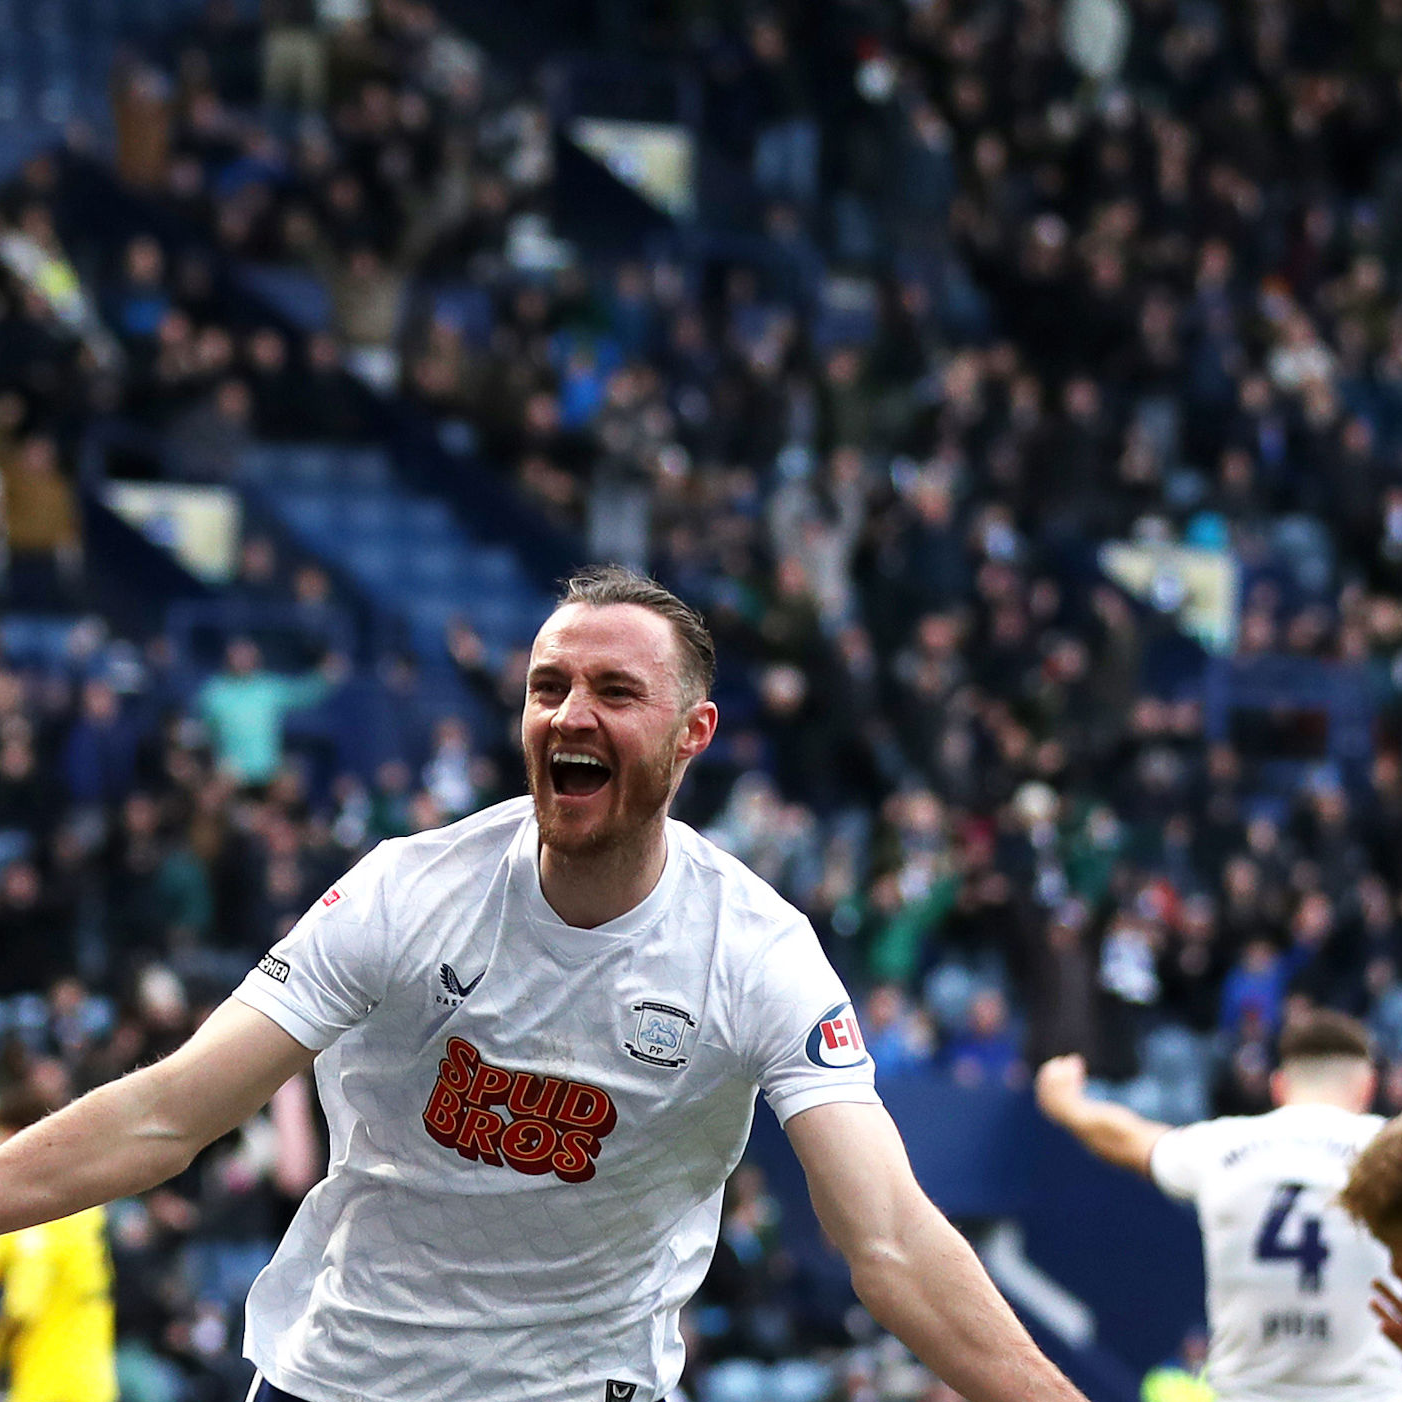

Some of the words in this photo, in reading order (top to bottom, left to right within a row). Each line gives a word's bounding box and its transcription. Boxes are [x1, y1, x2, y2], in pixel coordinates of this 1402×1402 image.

[423, 1077, 599, 1180] BROS
[439, 1037, 615, 1132] SPUD
[1256, 1183, 1329, 1293] 4
